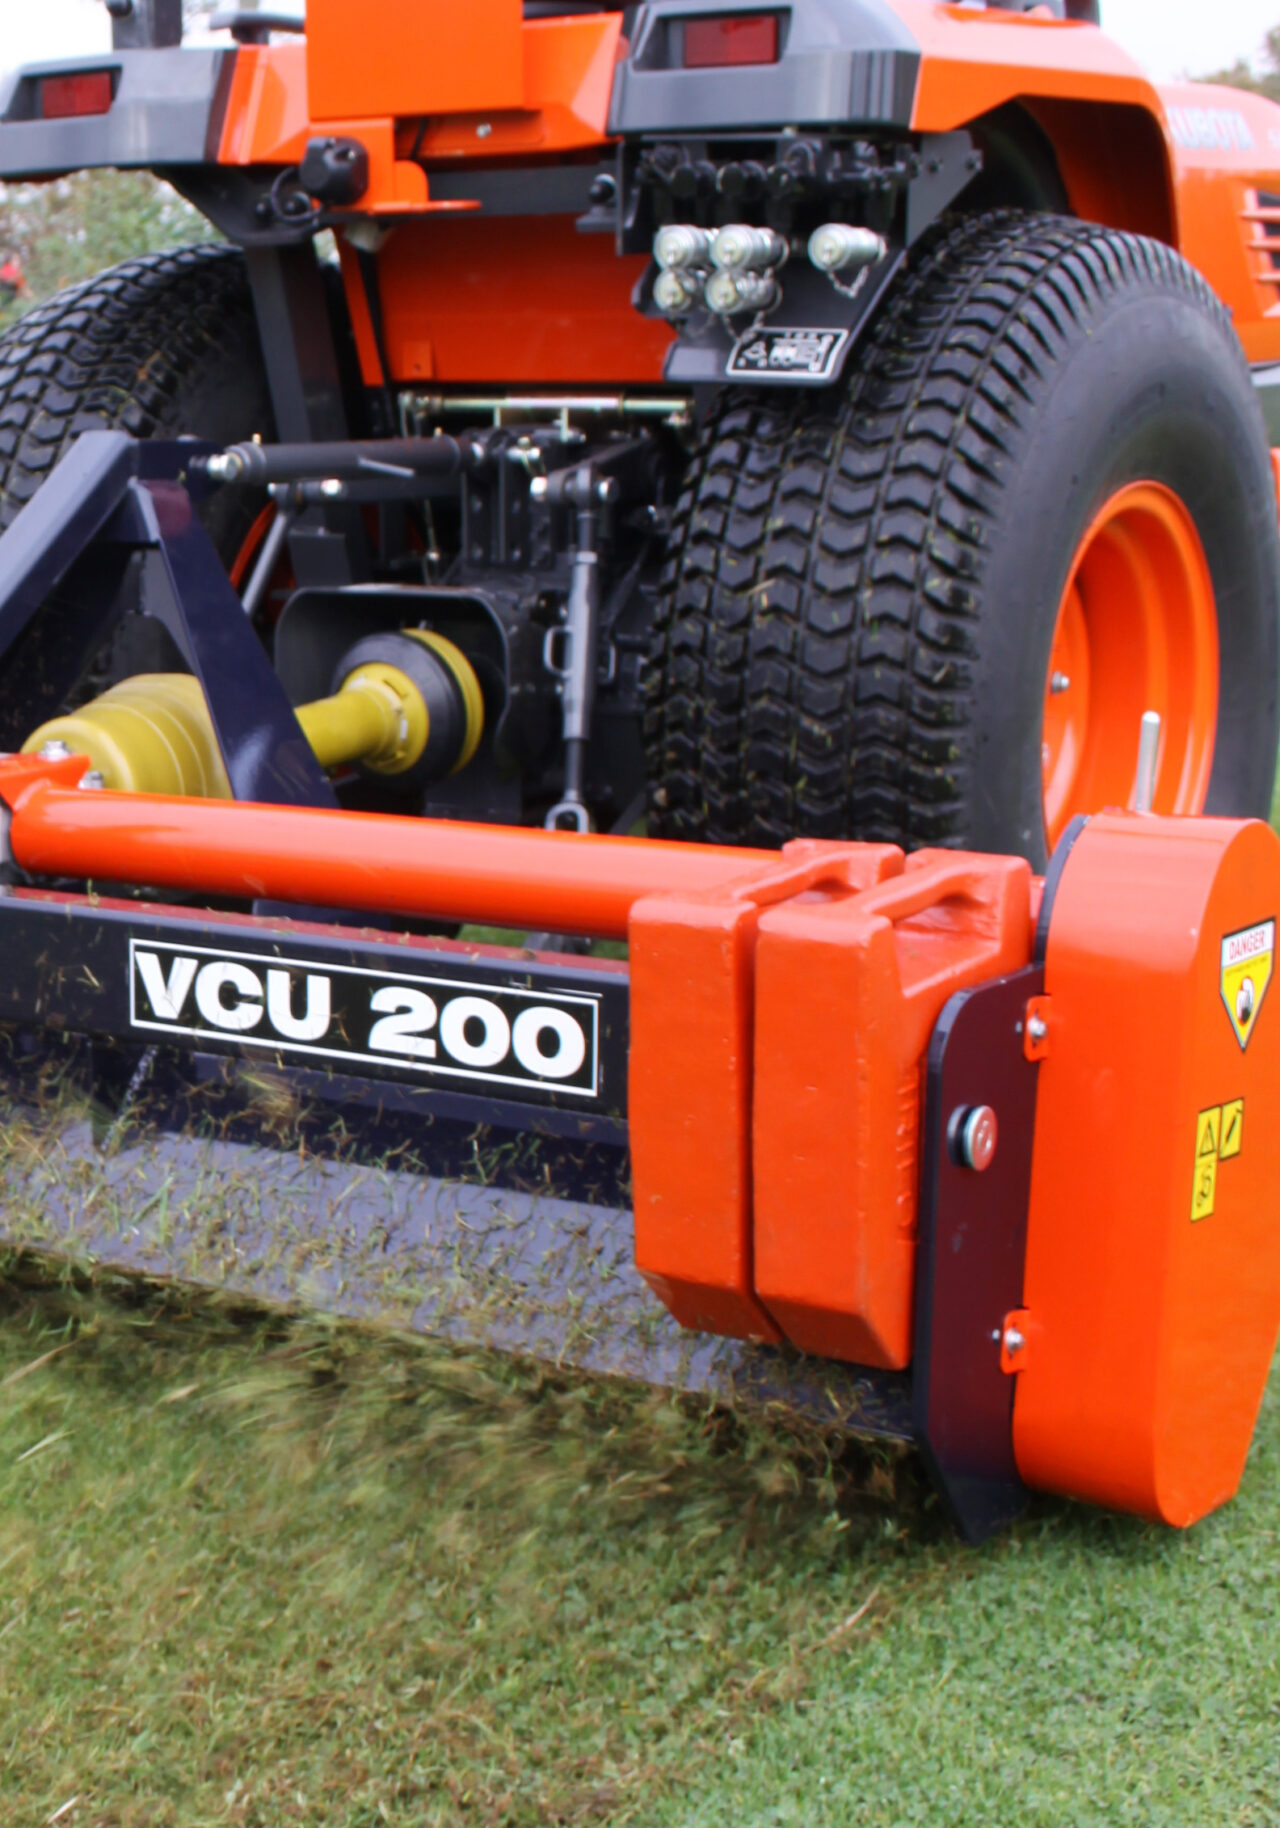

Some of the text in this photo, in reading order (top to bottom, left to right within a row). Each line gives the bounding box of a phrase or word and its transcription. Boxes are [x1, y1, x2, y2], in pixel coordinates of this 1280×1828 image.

[1229, 929, 1265, 961] DANGER
[134, 951, 587, 1080] VCU 200
